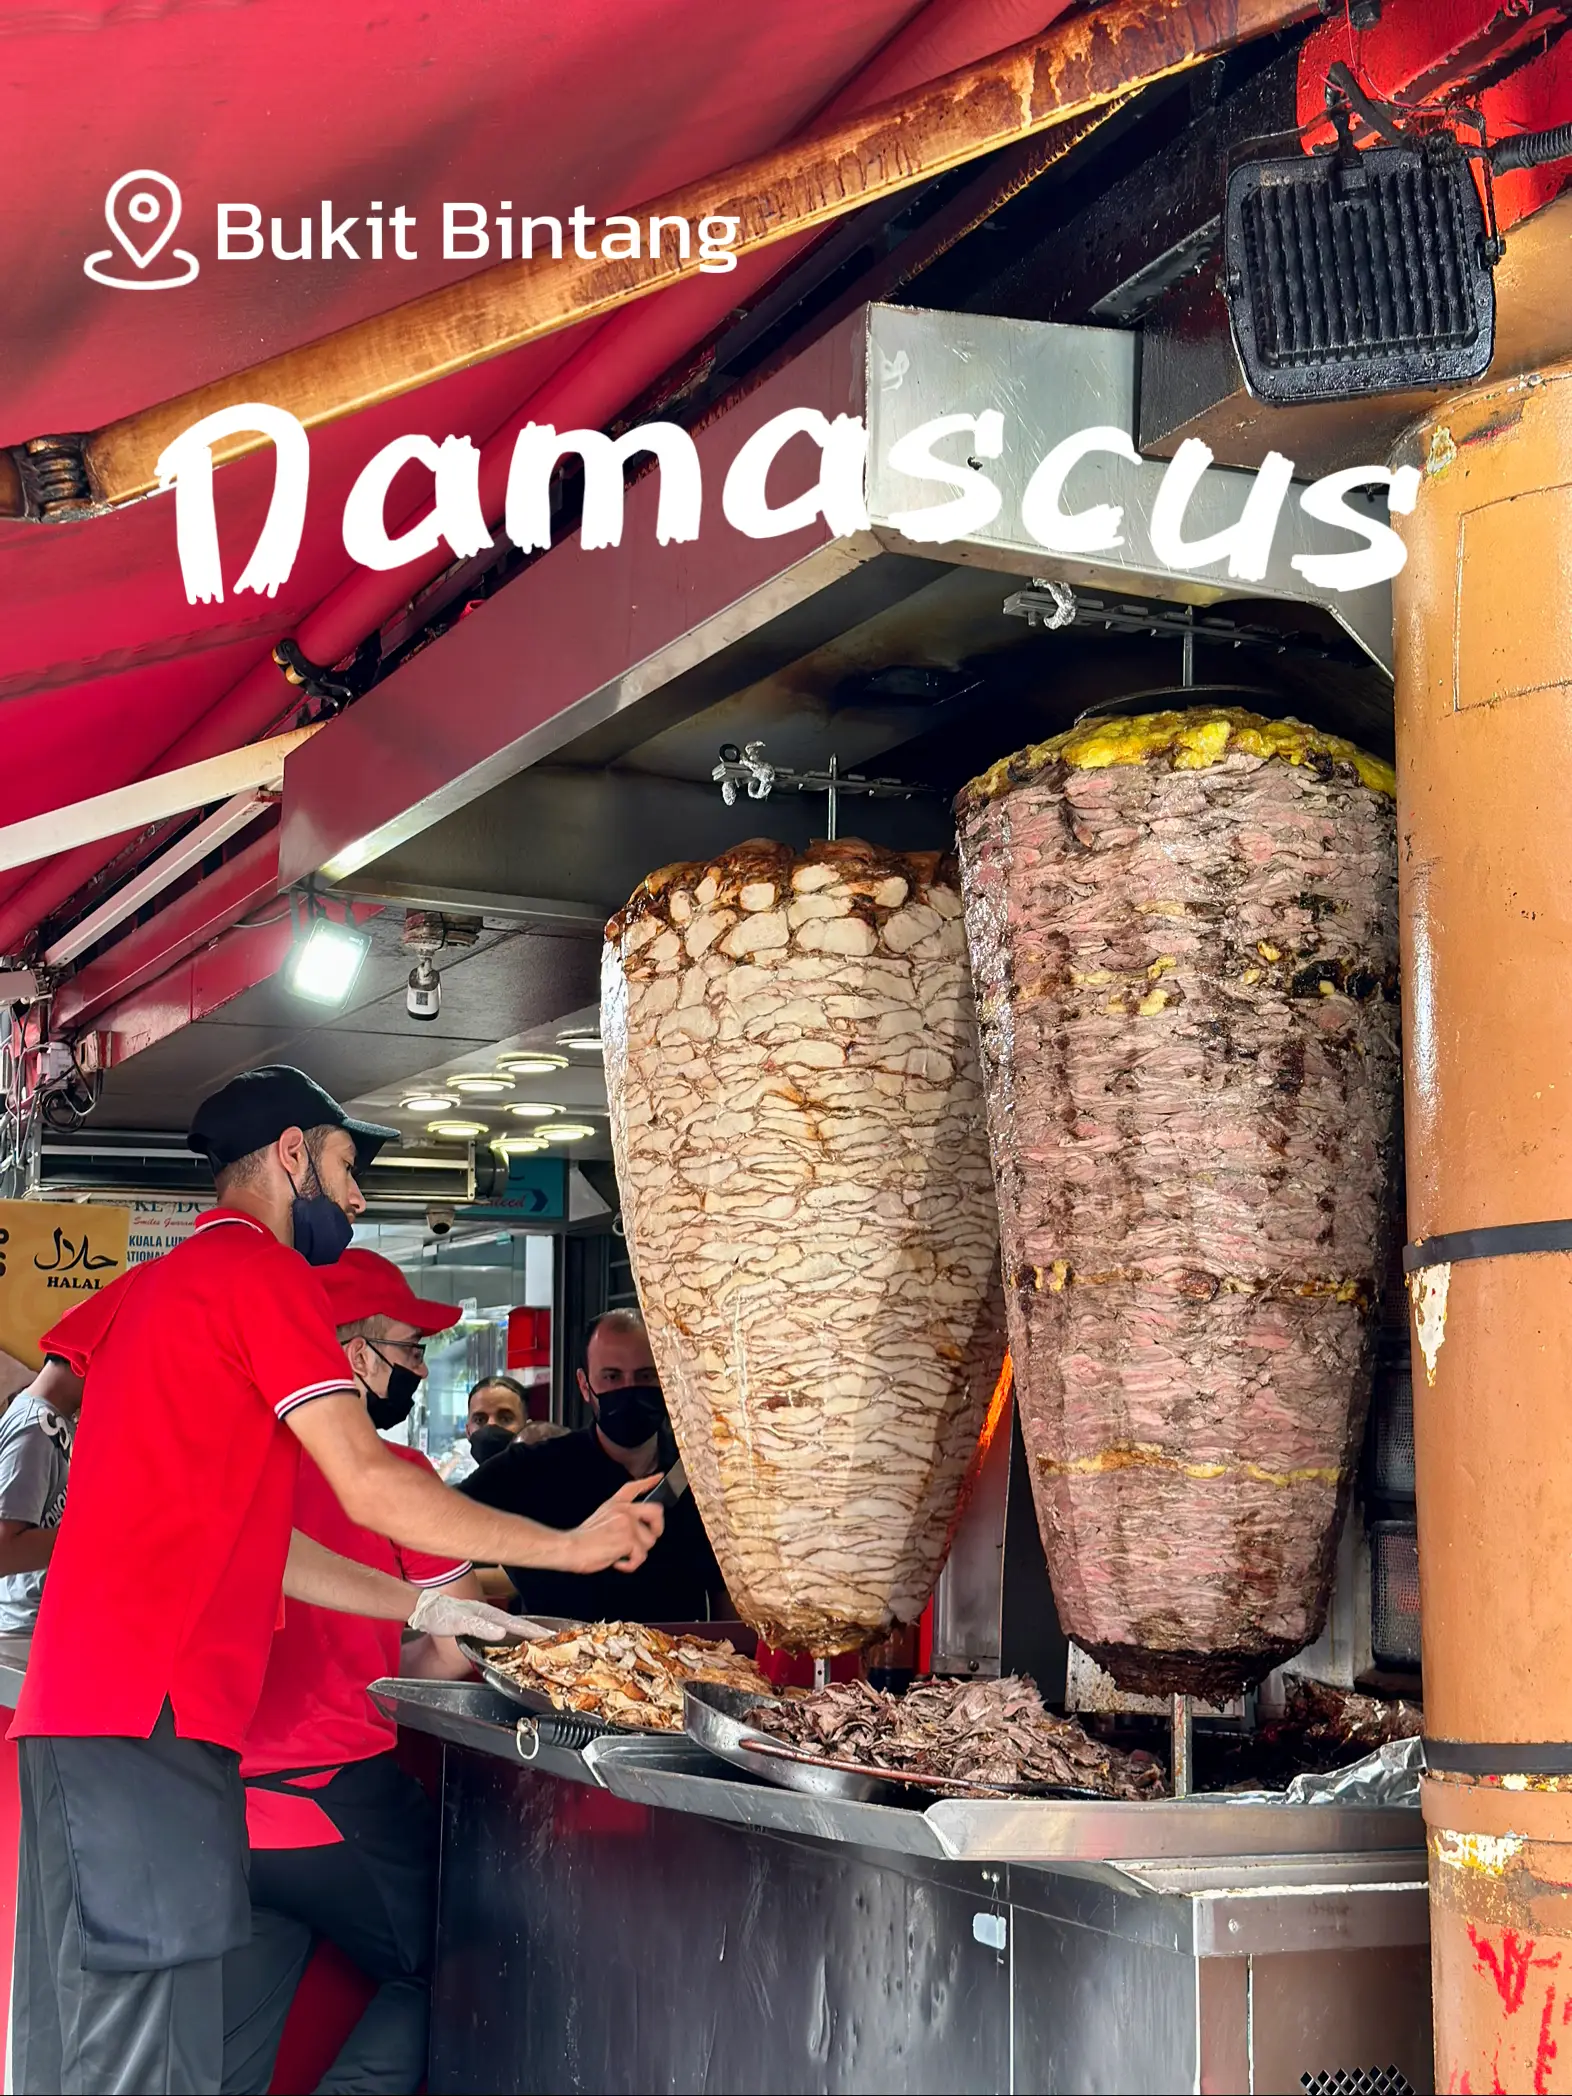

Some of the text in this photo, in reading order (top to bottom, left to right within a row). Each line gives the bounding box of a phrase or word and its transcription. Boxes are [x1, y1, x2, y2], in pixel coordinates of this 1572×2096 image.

[33, 1226, 119, 1271] حلال
[128, 1235, 163, 1248] KUALA
[46, 1275, 104, 1290] HALAL
